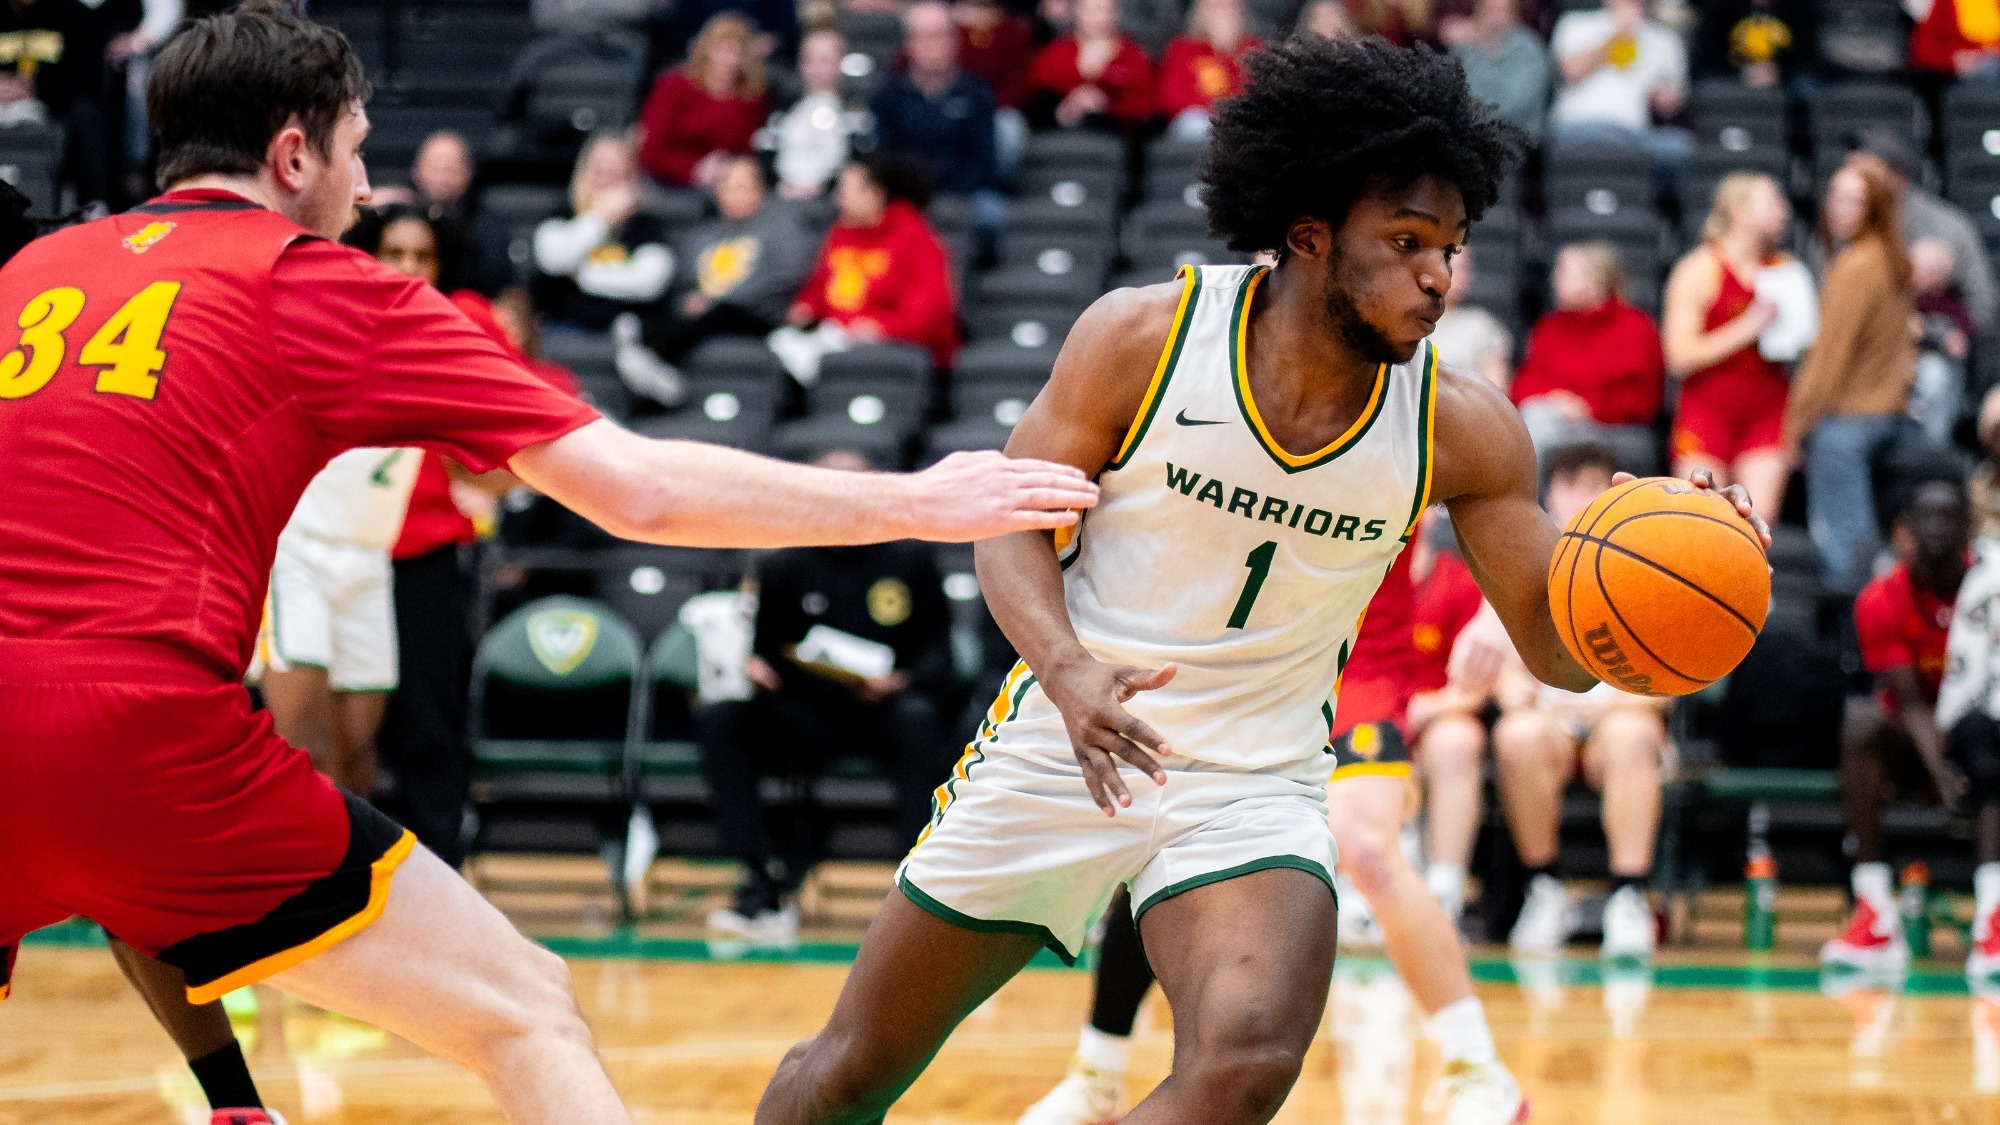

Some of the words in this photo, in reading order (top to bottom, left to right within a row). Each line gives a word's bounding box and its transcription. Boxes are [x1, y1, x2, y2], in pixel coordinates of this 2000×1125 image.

[0, 280, 183, 402] 34
[1166, 461, 1387, 542] WARRIORS
[1226, 540, 1278, 630] 1
